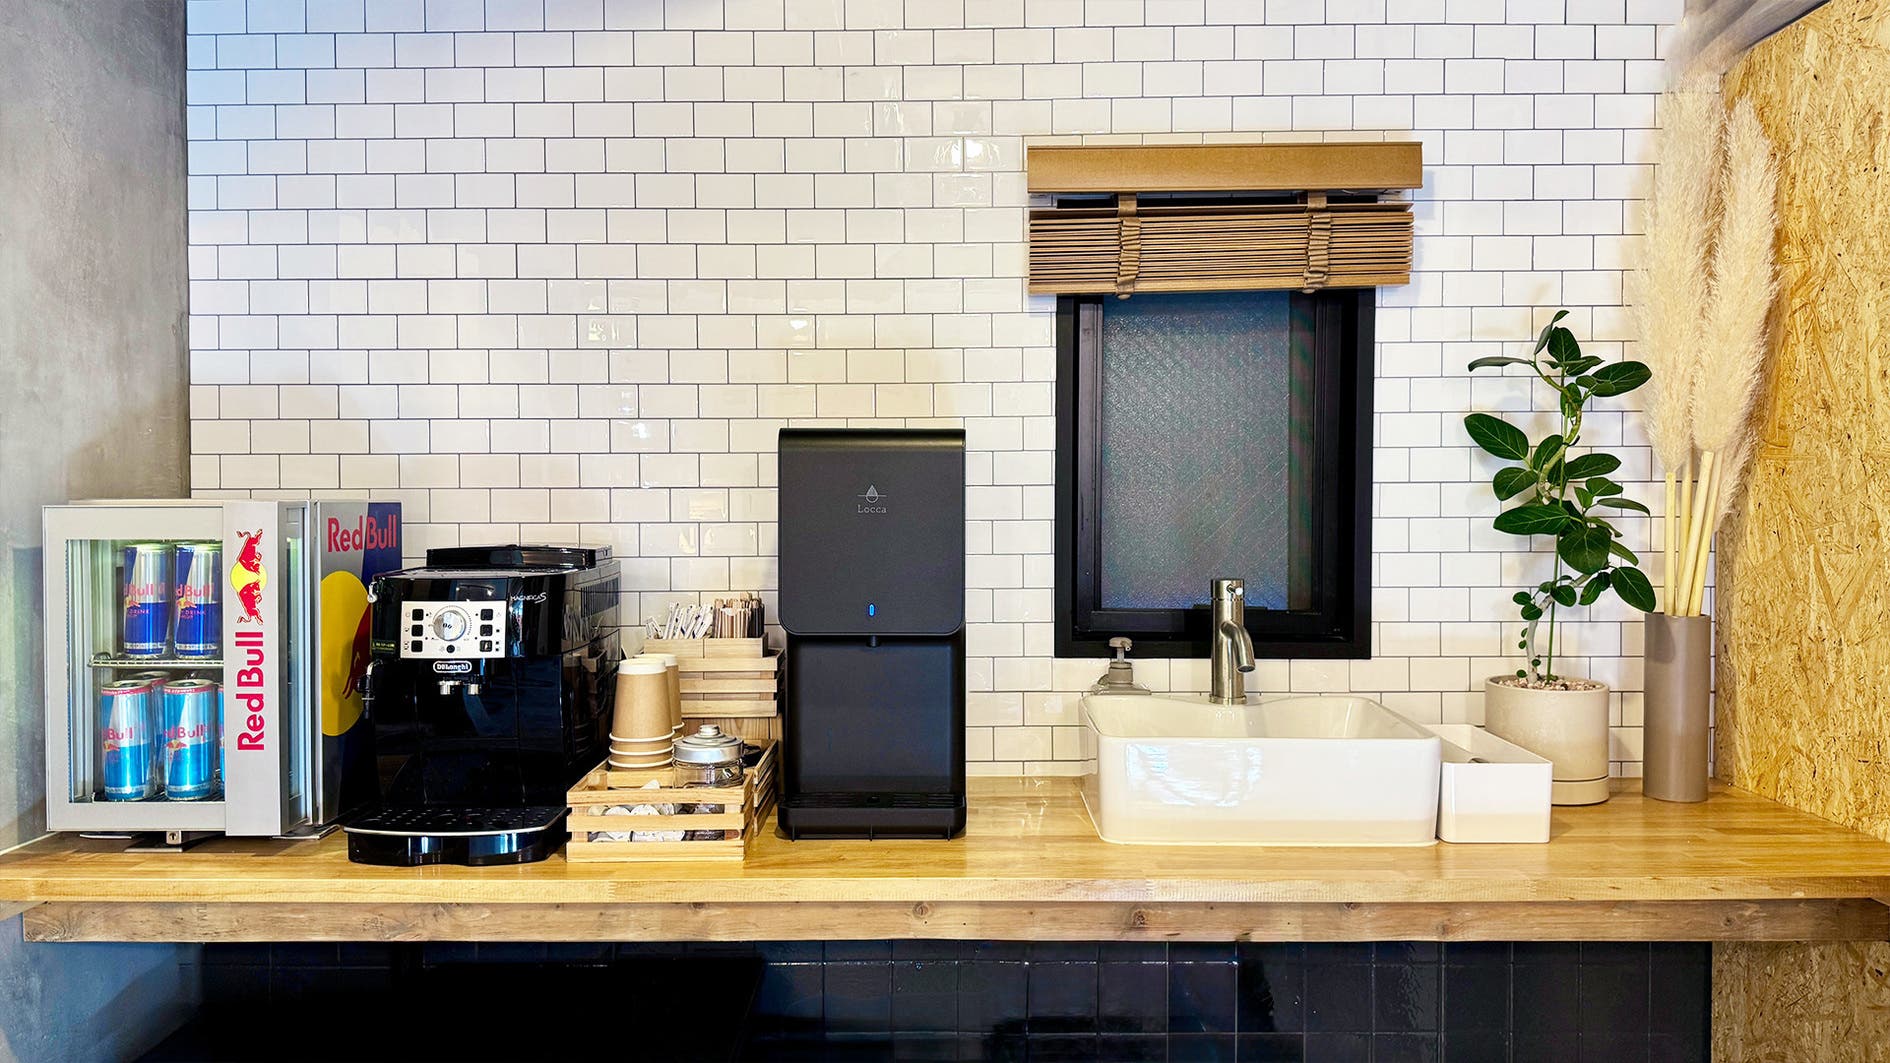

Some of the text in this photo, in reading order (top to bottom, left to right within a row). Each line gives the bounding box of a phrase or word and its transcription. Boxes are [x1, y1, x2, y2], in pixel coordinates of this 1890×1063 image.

[857, 504, 887, 514] Locca
[328, 514, 397, 552] Red Bull
[235, 631, 265, 750] Red Bull
[107, 727, 133, 740] Bull
[177, 724, 205, 739] Bull
